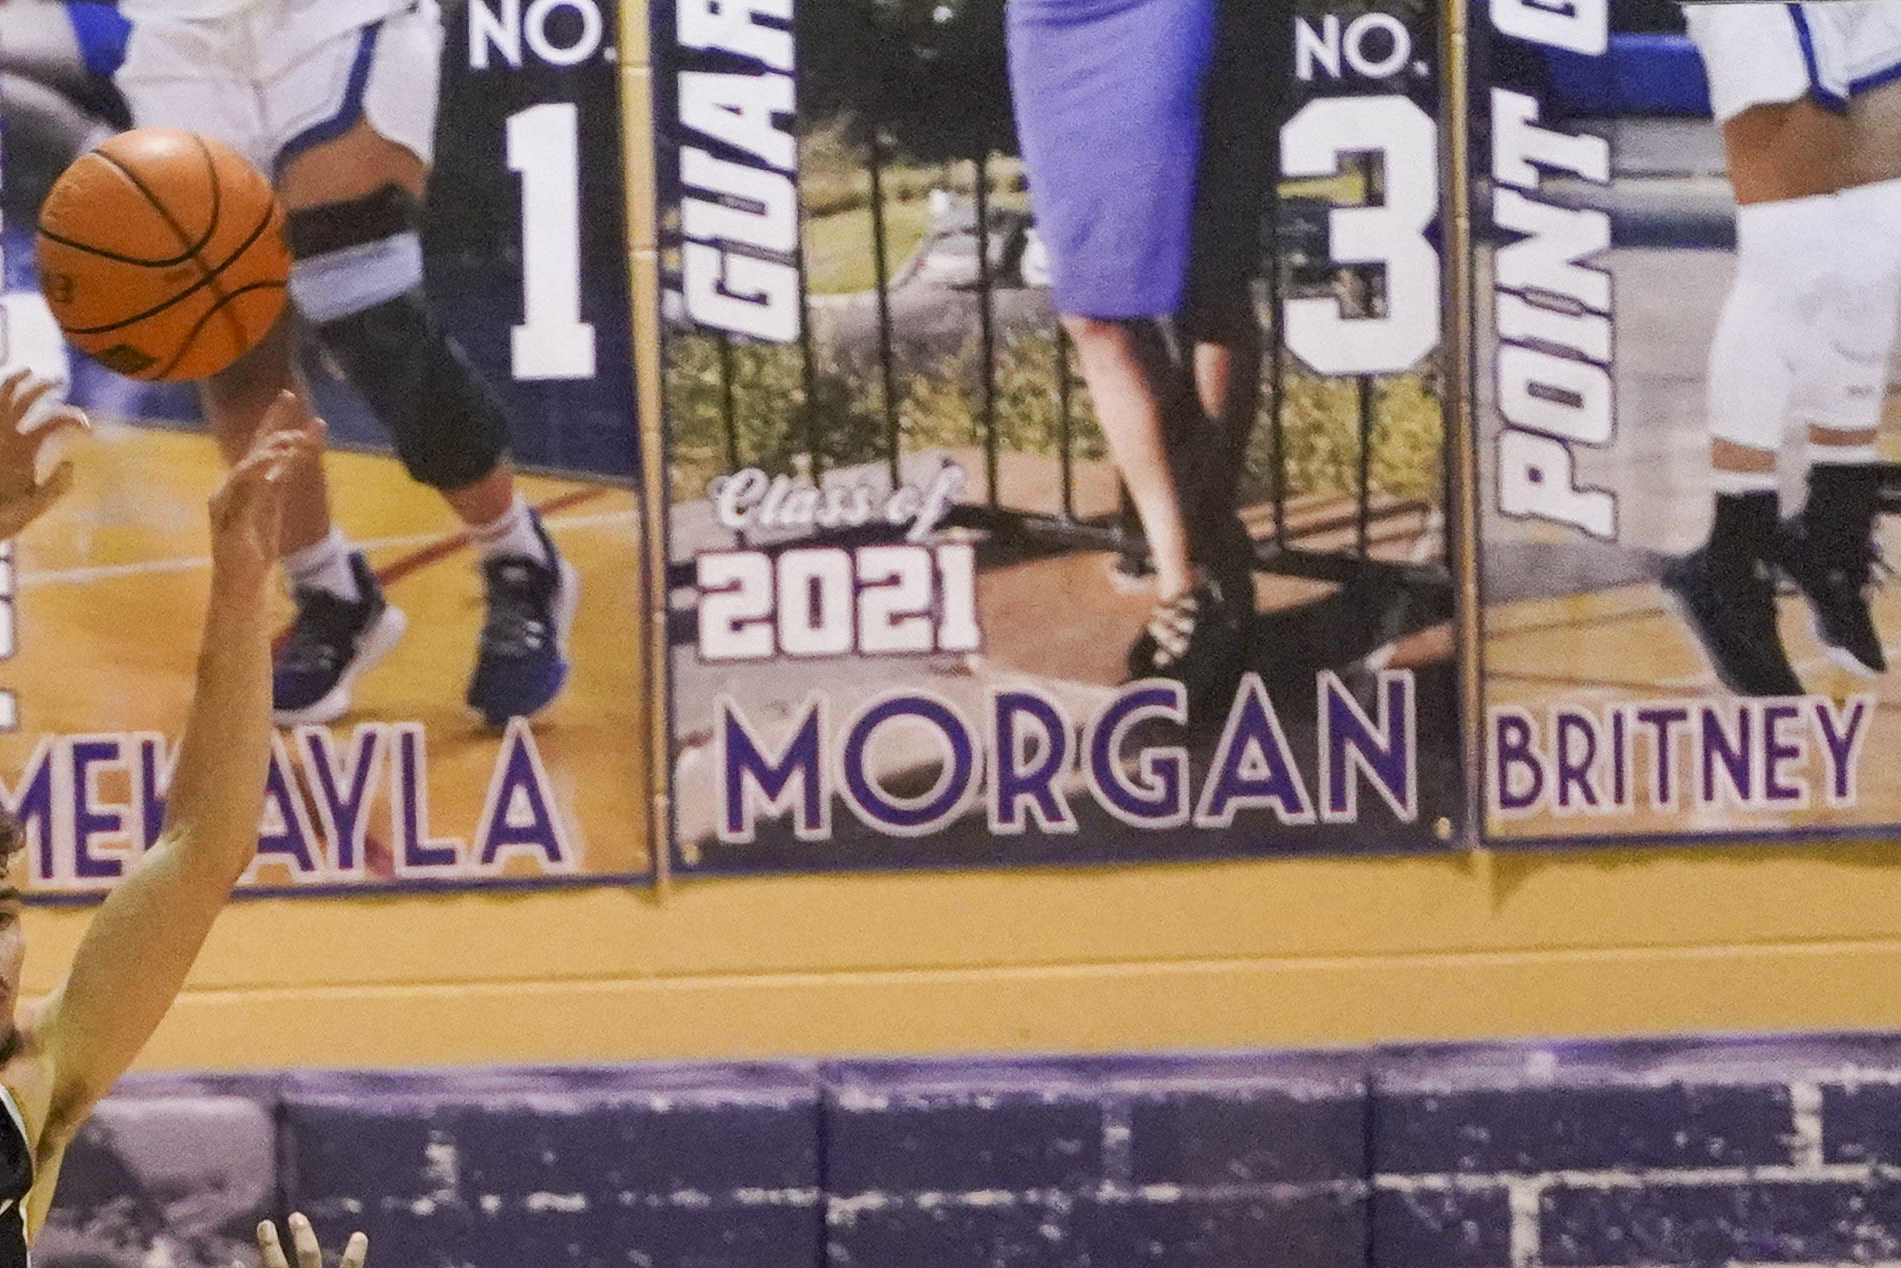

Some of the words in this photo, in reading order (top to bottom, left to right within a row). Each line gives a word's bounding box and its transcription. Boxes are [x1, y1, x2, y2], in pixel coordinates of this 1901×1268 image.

[468, 0, 618, 70] NO.
[1295, 12, 1431, 80] NO.
[507, 102, 597, 380] 1
[1280, 95, 1441, 376] 3
[1490, 86, 1617, 541] POINT
[706, 467, 873, 528] Class
[885, 463, 966, 542] of
[698, 546, 982, 659] 2021
[717, 670, 1417, 842] MORGAN
[1489, 694, 1876, 815] BRITNEY
